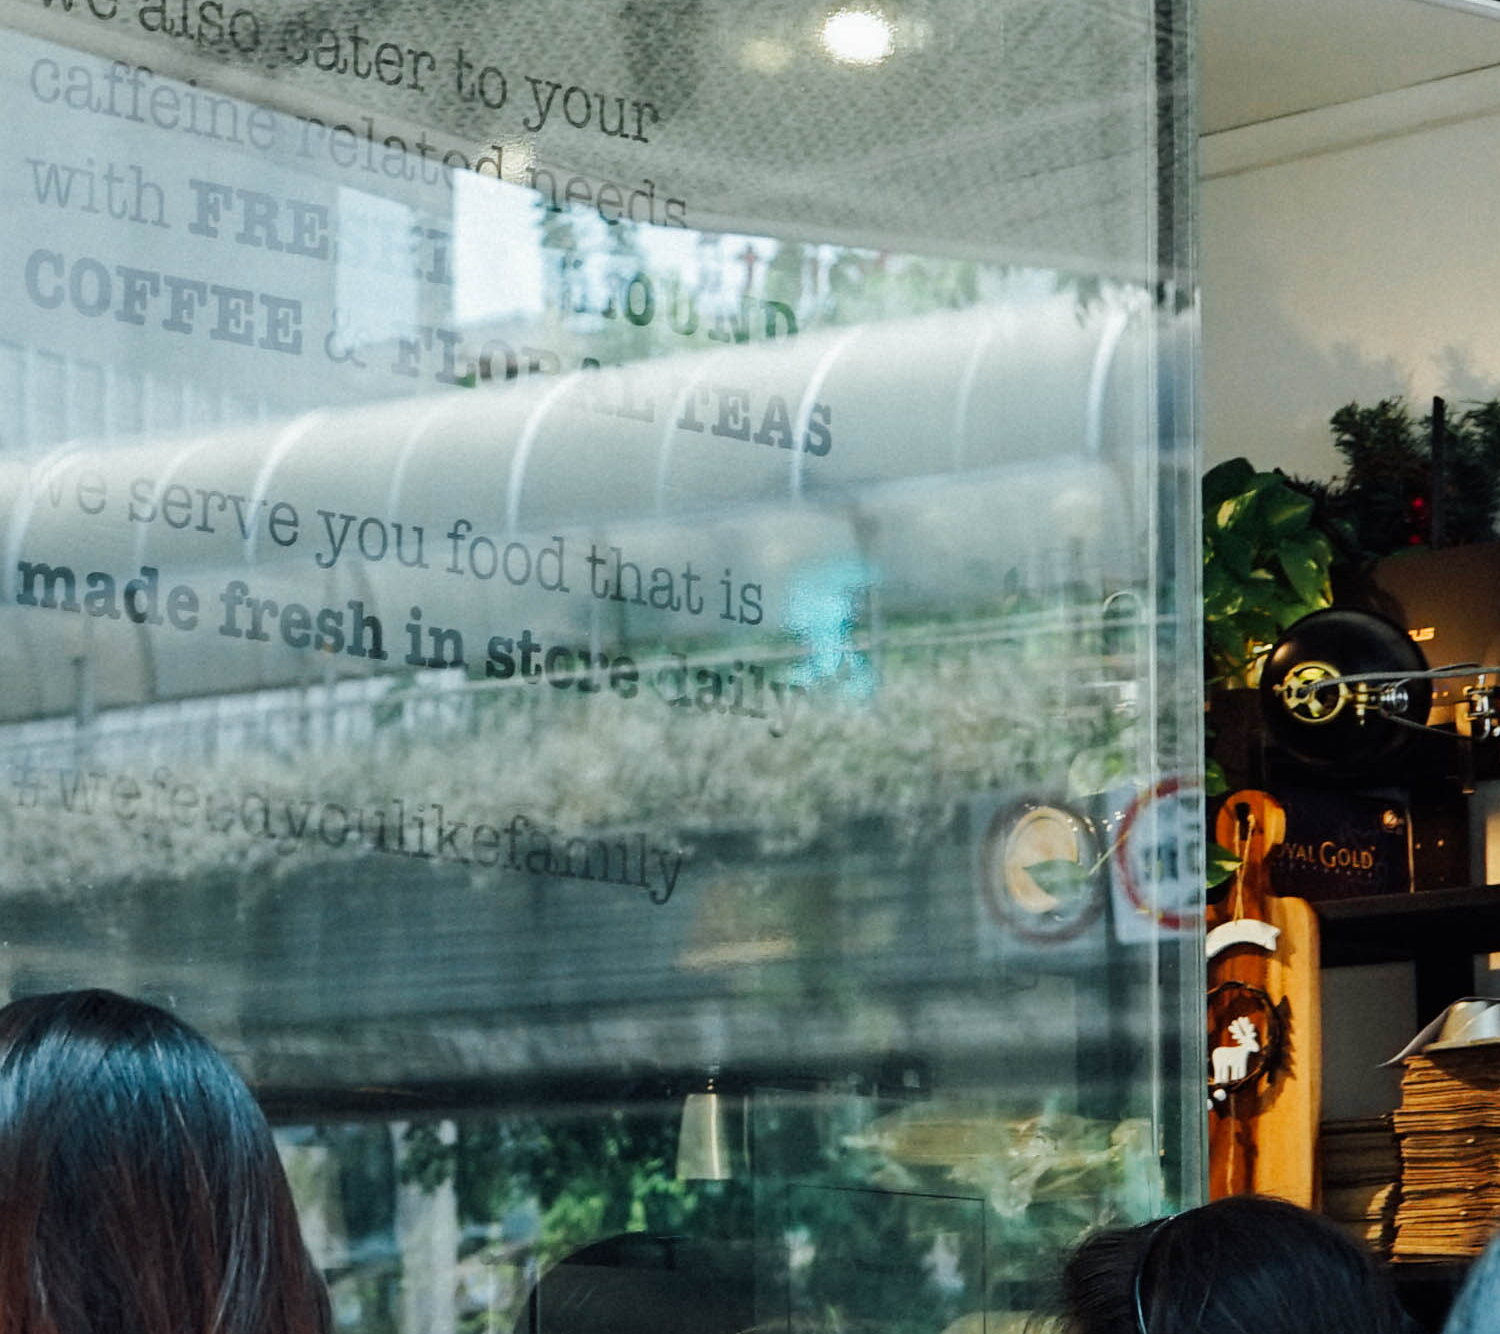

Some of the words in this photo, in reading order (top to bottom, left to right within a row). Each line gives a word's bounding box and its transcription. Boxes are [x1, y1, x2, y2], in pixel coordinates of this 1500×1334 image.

[28, 55, 281, 152] caffeine
[295, 111, 503, 184] related
[526, 165, 688, 229] needs
[277, 19, 437, 94] cater
[452, 48, 509, 111] to
[522, 74, 660, 144] your
[25, 155, 171, 229] with
[25, 248, 304, 356] COFFEE
[677, 384, 833, 458] TEAS
[126, 478, 302, 546] serve
[314, 509, 430, 570] you
[446, 519, 571, 596] food
[585, 543, 704, 616] that
[716, 567, 765, 626] is
[15, 558, 201, 631] made
[216, 579, 389, 662] fresh
[403, 604, 471, 669] in
[485, 627, 641, 700] store
